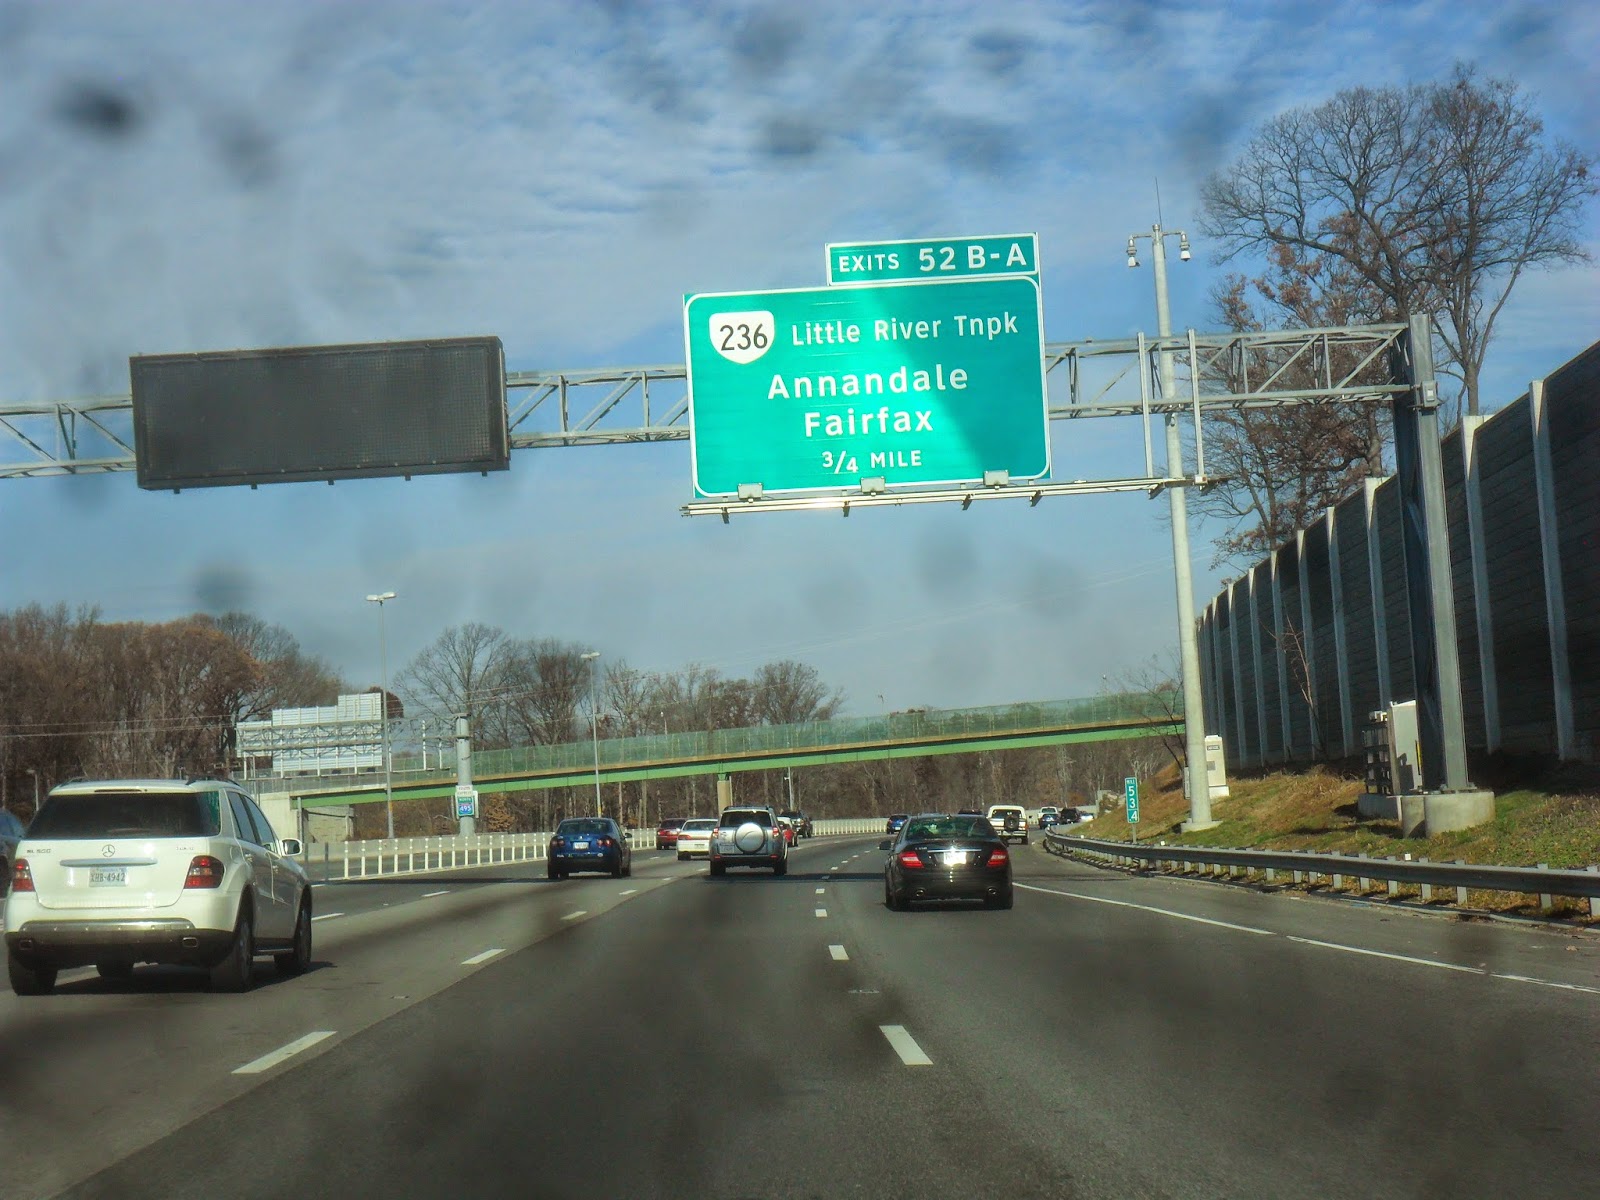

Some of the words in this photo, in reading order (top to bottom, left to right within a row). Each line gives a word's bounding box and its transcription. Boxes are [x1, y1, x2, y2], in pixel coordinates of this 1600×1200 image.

[838, 253, 900, 273] EXITS
[918, 247, 956, 272] 52
[967, 243, 1027, 269] B-A
[719, 323, 769, 351] 236
[791, 320, 861, 346] Little
[874, 317, 942, 341] River
[953, 311, 1018, 340] Tnpk
[767, 364, 969, 400] Annandale
[804, 406, 933, 437] Fairfax
[821, 450, 859, 474] 3/4
[870, 449, 922, 469] MILE
